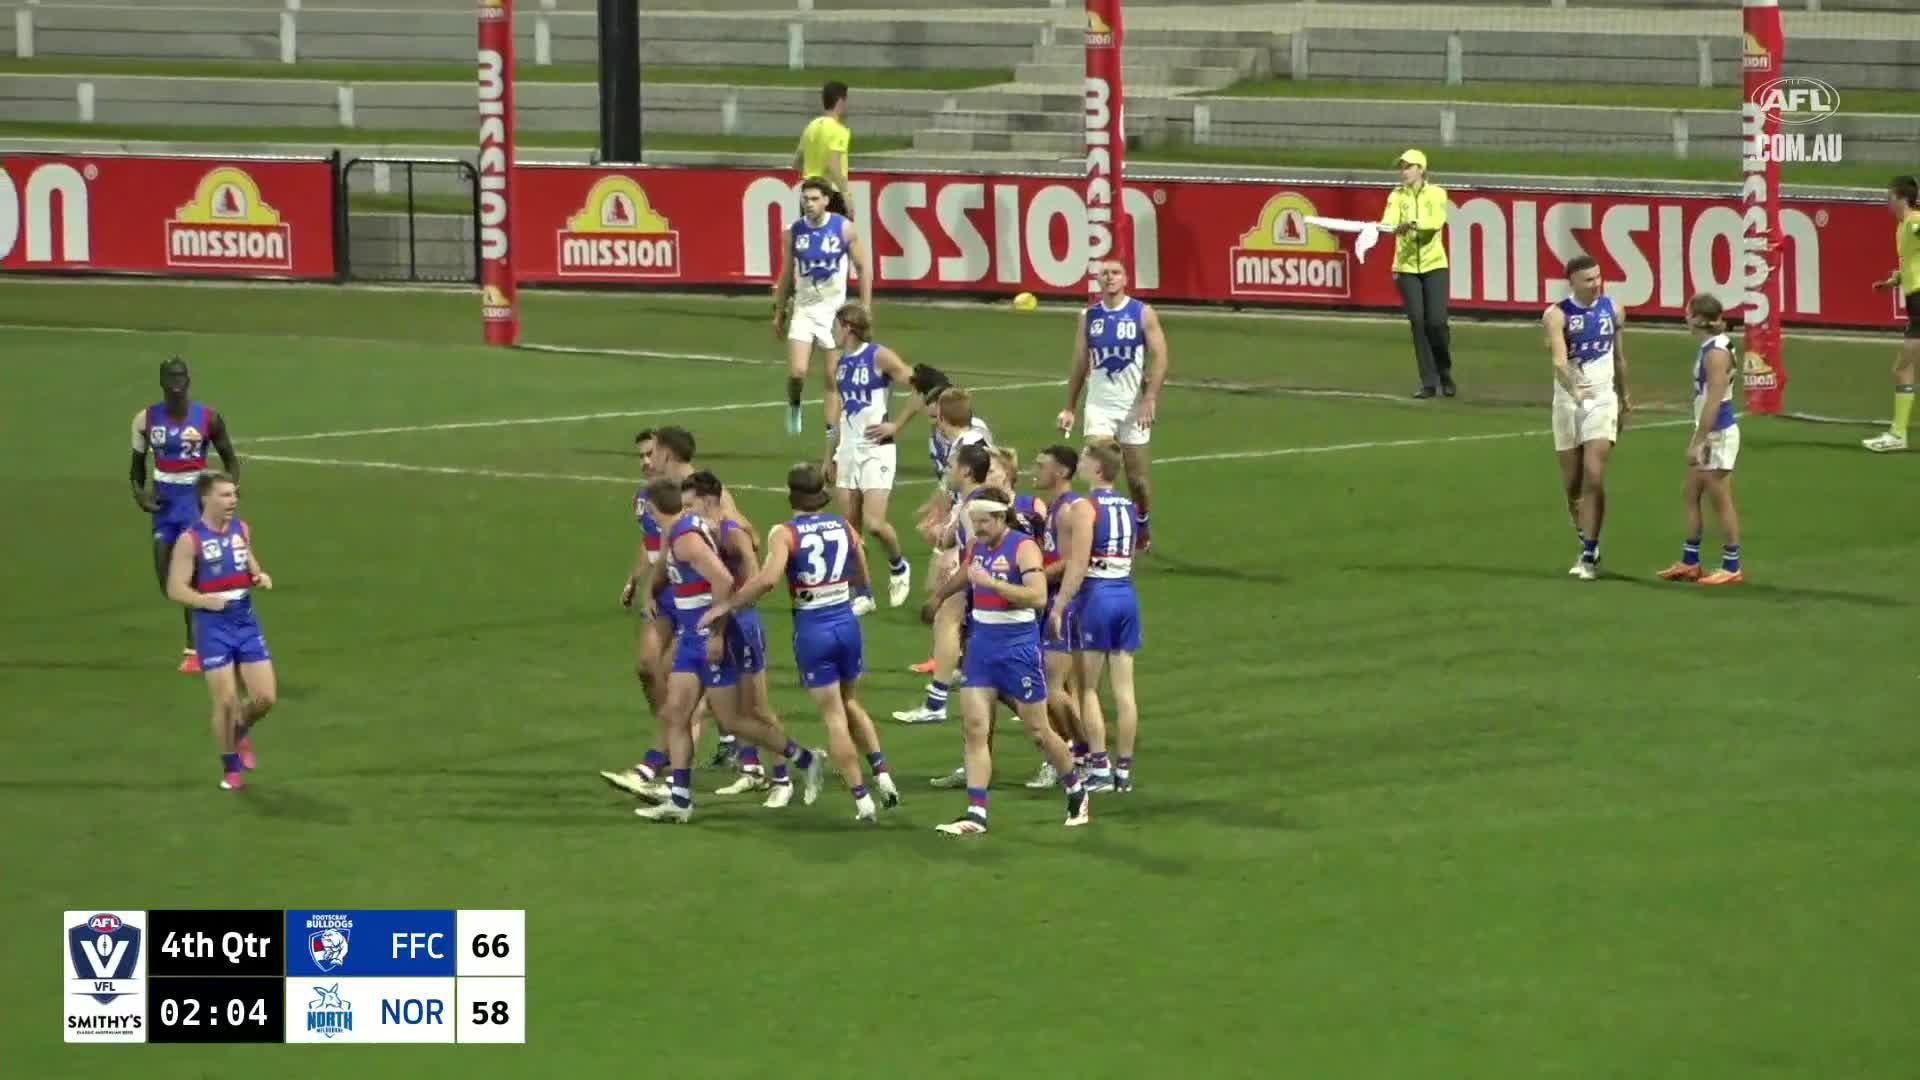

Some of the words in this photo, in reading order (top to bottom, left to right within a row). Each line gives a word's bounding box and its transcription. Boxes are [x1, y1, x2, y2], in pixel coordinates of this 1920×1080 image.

[172, 229, 284, 259] MISSION
[563, 238, 672, 267] MISSION
[820, 236, 841, 253] 42
[1236, 256, 1343, 288] MISSION
[1116, 321, 1136, 340] 80
[1599, 318, 1614, 336] 21
[851, 367, 870, 385] 48
[1107, 506, 1132, 556] 11
[798, 529, 848, 585] 37
